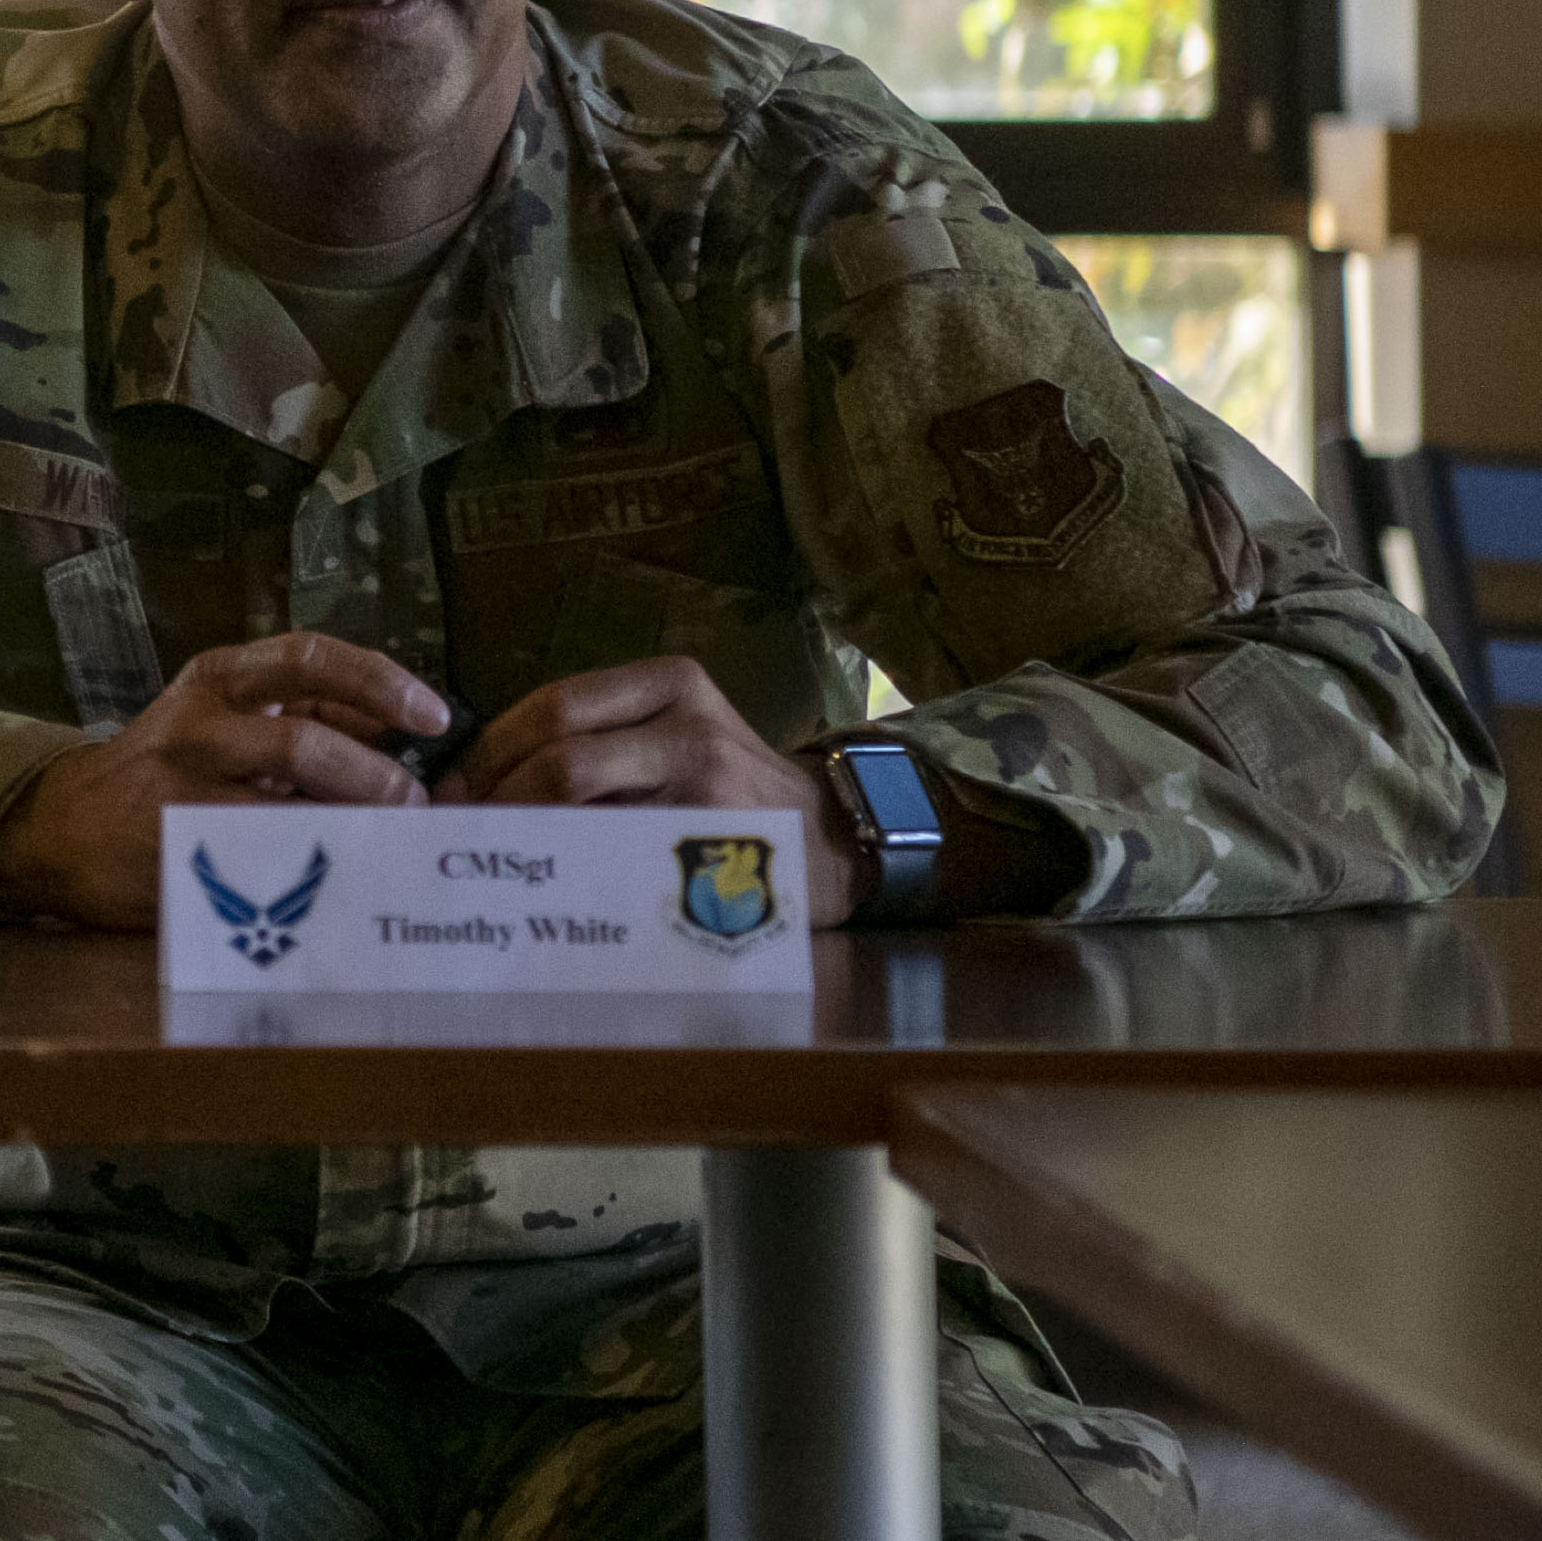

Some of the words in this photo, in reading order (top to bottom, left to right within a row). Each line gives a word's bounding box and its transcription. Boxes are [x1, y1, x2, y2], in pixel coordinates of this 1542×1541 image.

[543, 481, 613, 534] AIR
[436, 850, 557, 887] CMSgt
[375, 914, 517, 952] Timothy
[526, 916, 629, 946] White
